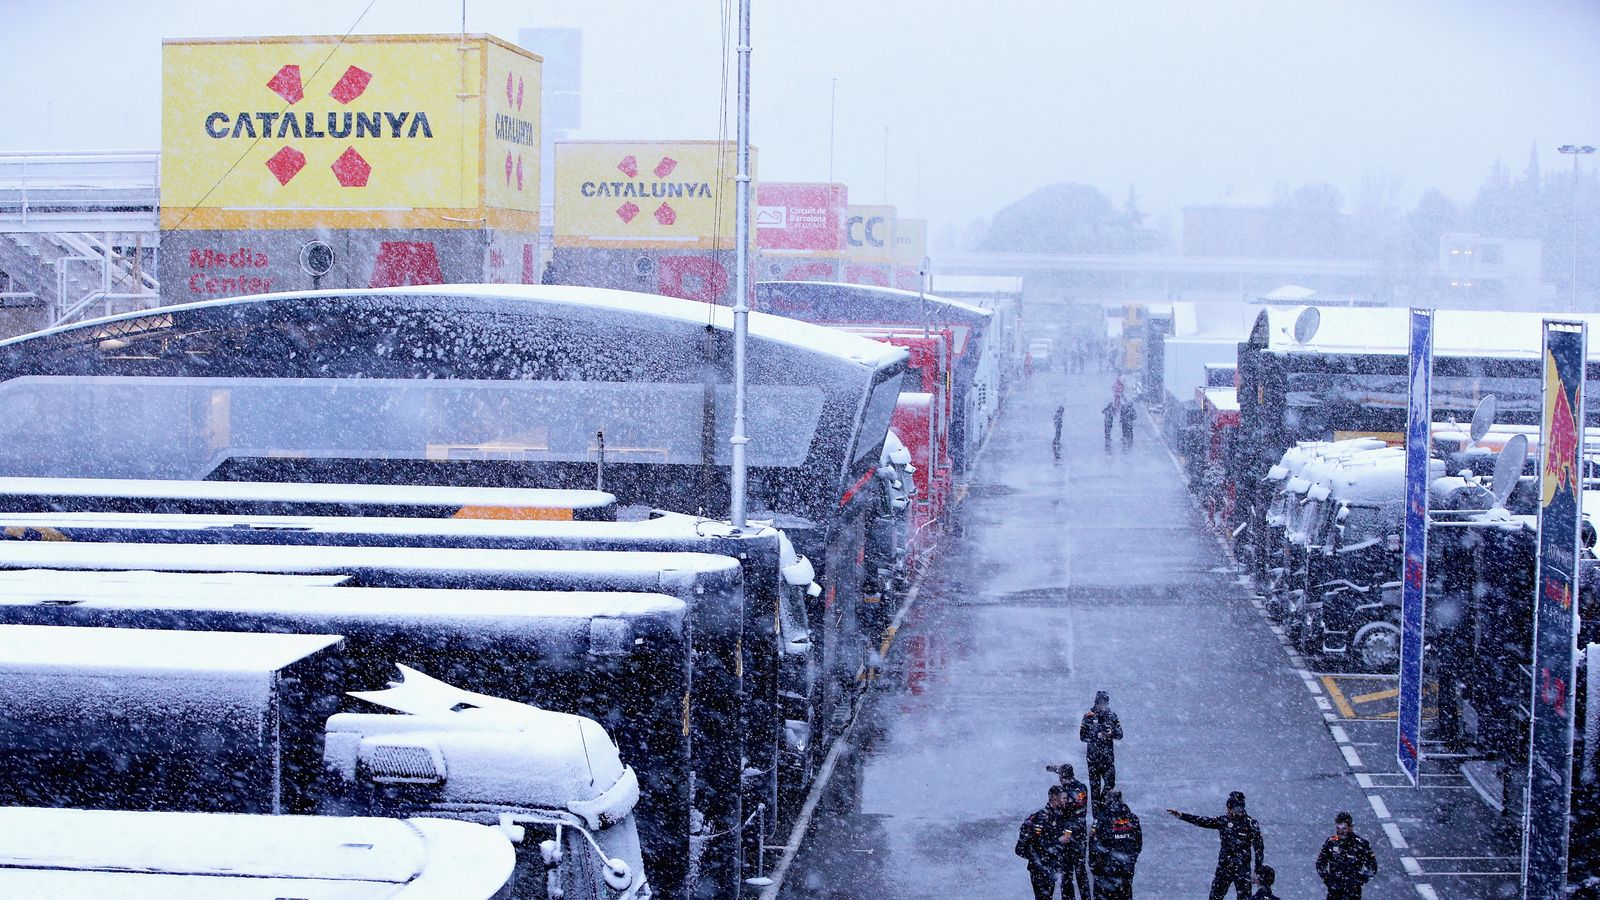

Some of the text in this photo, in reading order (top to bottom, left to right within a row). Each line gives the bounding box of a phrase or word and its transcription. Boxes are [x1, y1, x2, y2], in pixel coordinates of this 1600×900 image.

[205, 112, 433, 139] CATALUNYA
[495, 112, 533, 146] CATALUNYA
[581, 181, 712, 198] CATALUNYA
[190, 247, 269, 268] Media
[189, 273, 273, 293] Center
